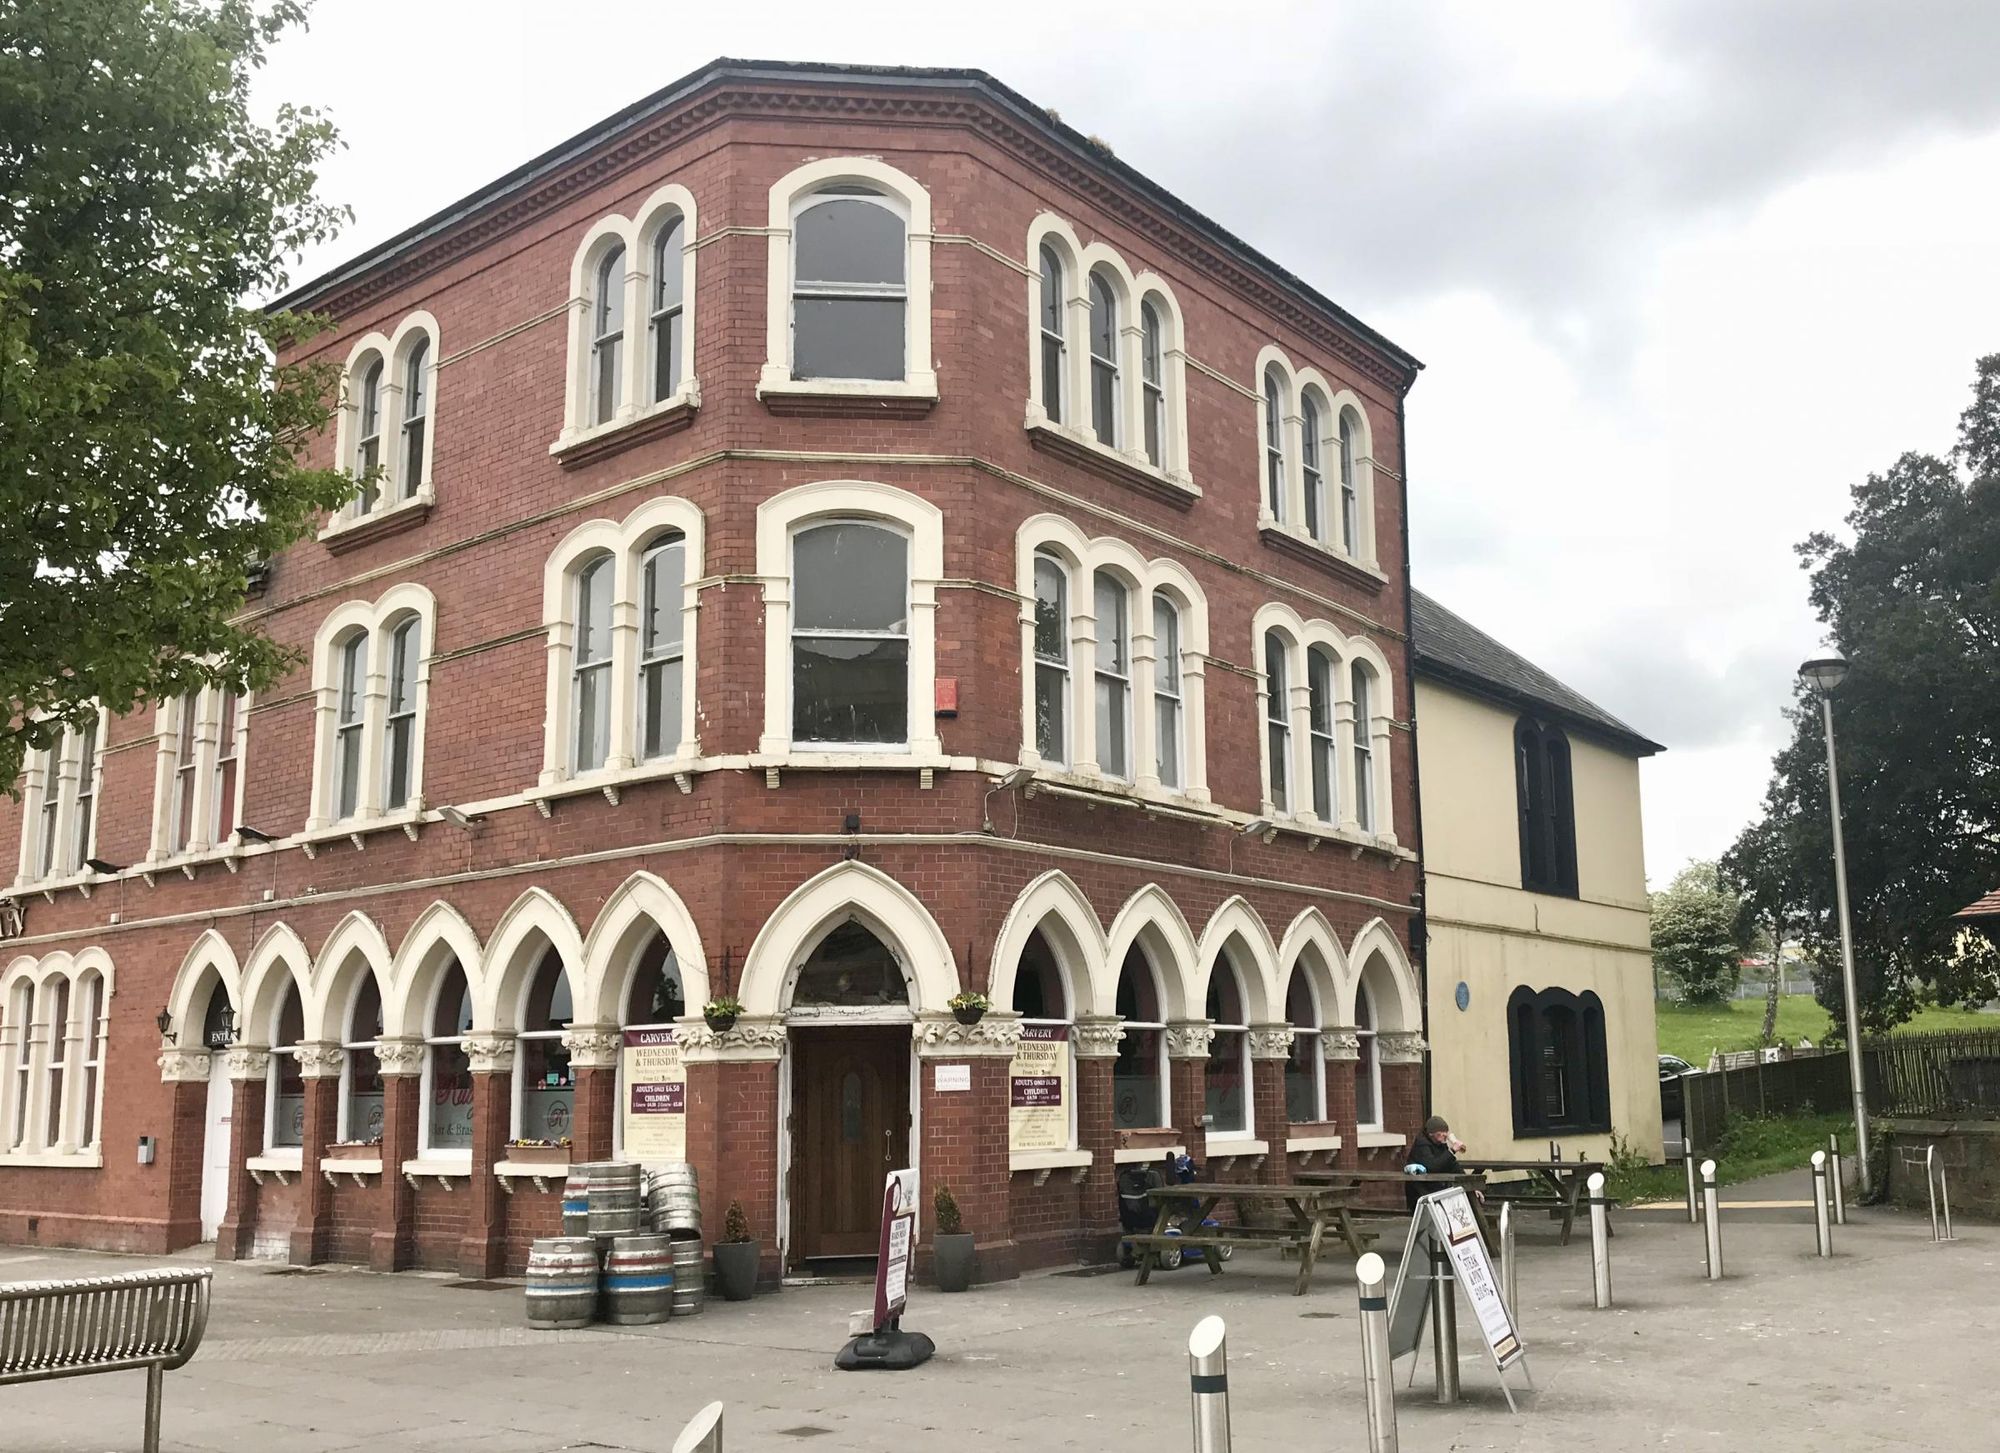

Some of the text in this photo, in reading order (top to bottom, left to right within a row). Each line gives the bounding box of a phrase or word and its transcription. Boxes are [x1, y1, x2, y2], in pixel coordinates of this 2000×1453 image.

[1021, 1029, 1053, 1038] ARVERY
[1017, 1043, 1056, 1051] WEDNESDAY
[636, 1047, 679, 1057] WEDNESDAY
[1016, 1051, 1057, 1060] & THURSDAY
[635, 1057, 679, 1067] & THURSDAY
[644, 1094, 670, 1102] CHILDREN
